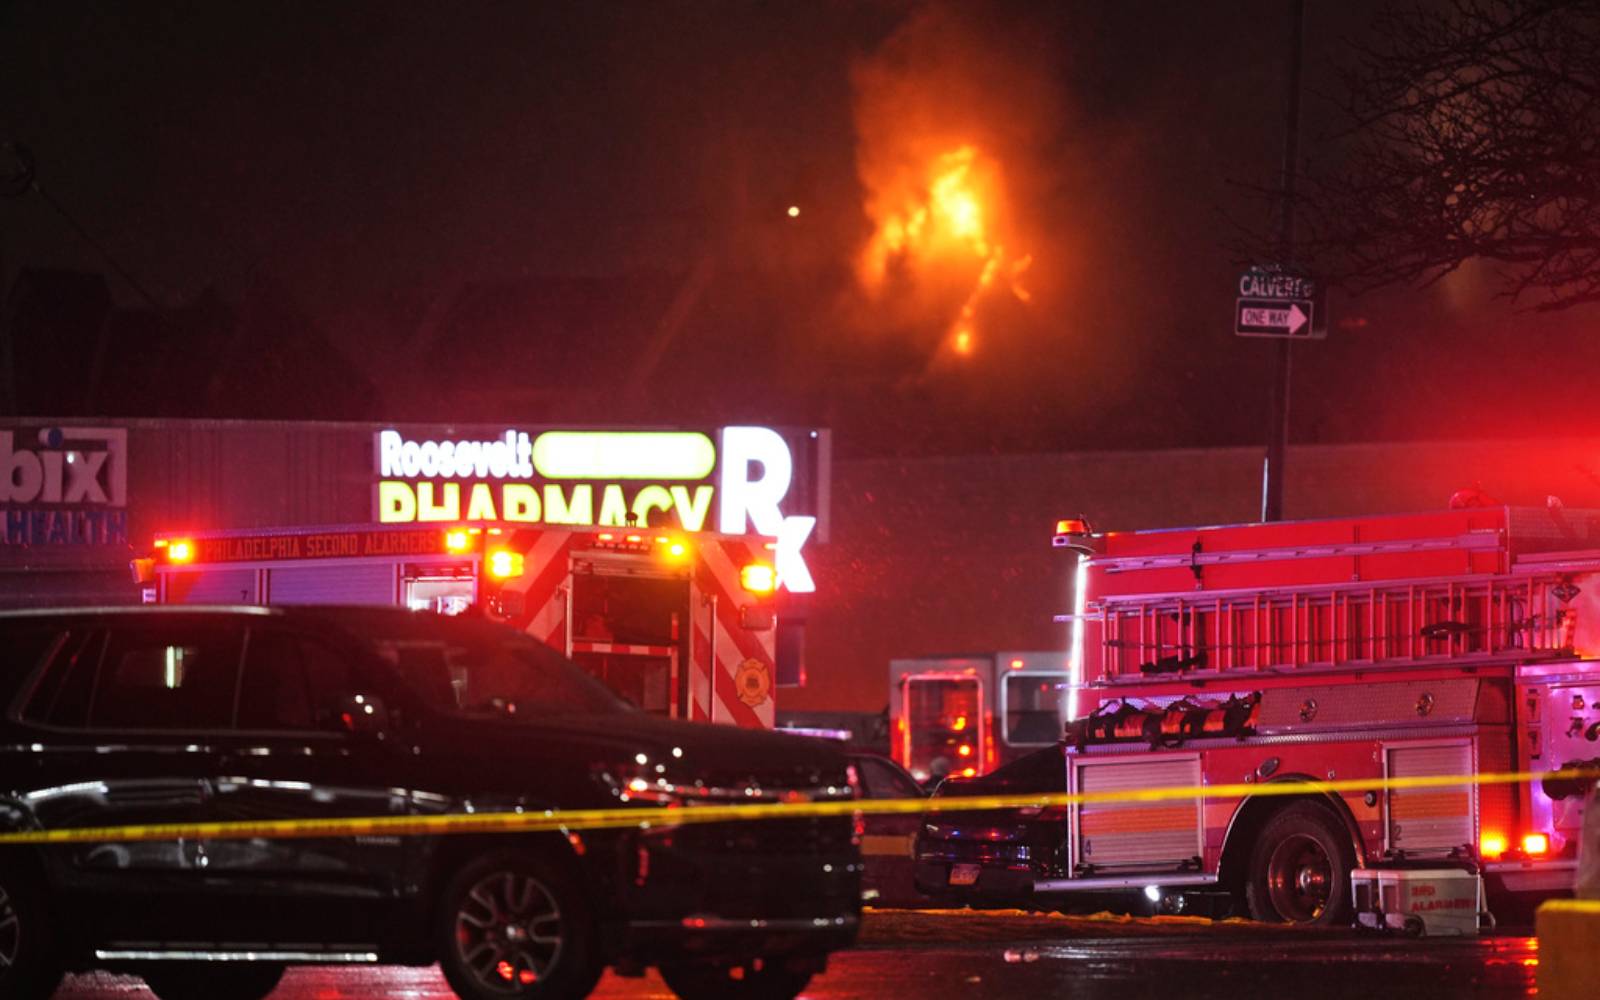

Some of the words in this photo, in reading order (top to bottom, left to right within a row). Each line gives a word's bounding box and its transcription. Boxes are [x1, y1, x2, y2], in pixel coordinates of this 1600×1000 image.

[1240, 275, 1302, 297] CALVERT
[1245, 310, 1265, 325] ONE
[1268, 311, 1290, 326] WAY
[380, 430, 533, 478] Roosevelt
[7, 511, 127, 545] HEALTH
[206, 537, 300, 561] PHILADELPHIA
[306, 534, 358, 557] SECOND
[365, 530, 438, 554] ALARMERS
